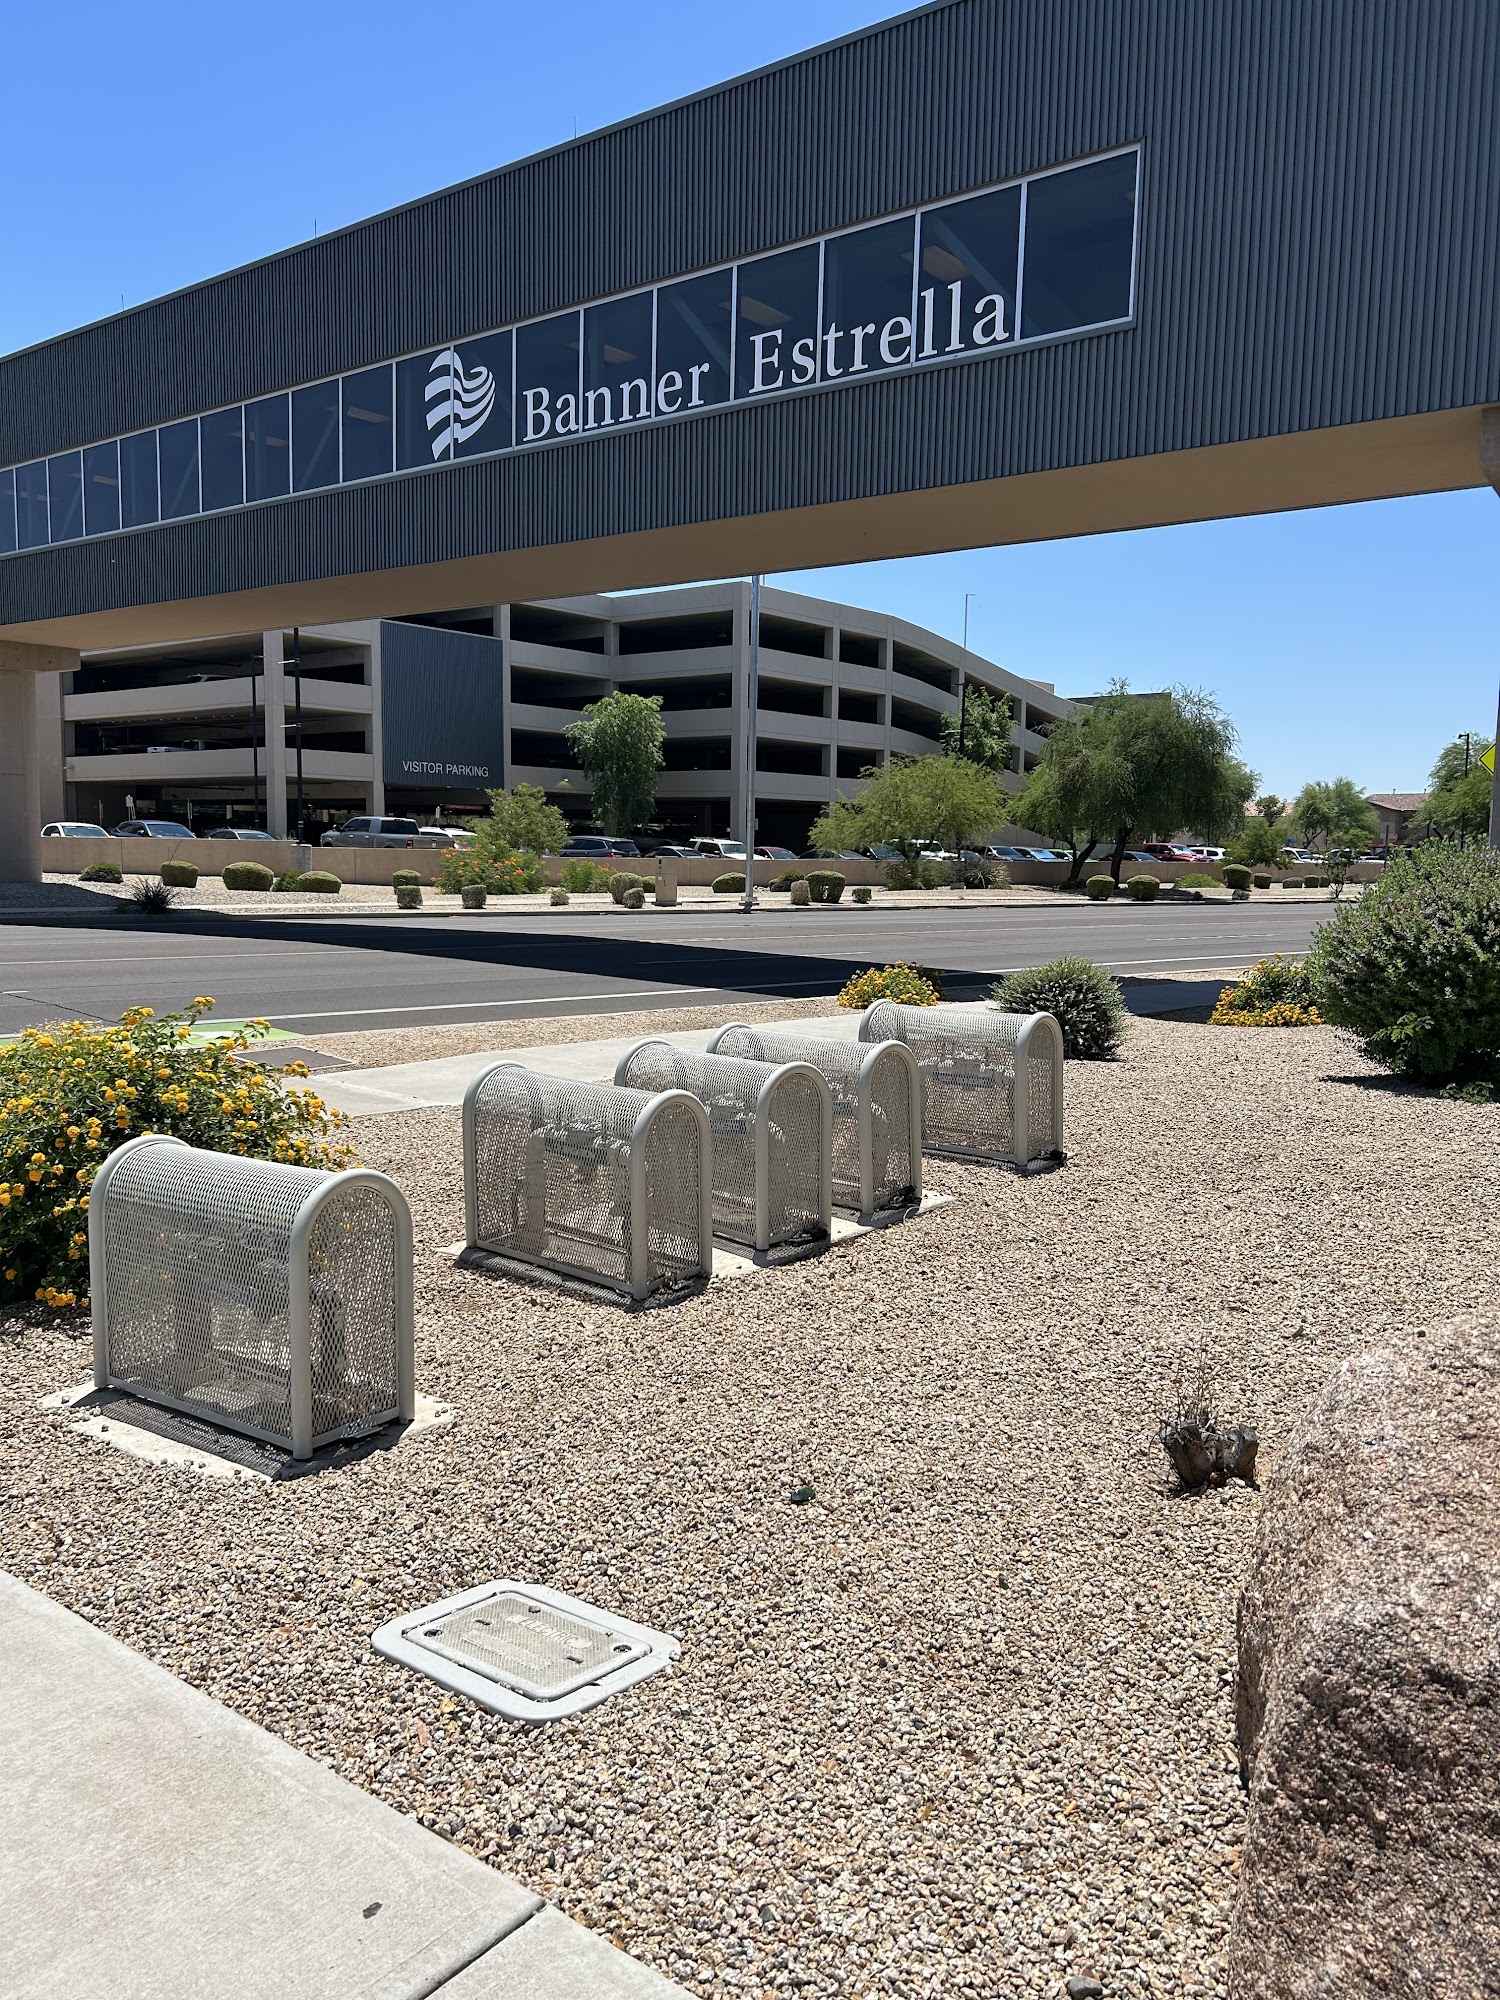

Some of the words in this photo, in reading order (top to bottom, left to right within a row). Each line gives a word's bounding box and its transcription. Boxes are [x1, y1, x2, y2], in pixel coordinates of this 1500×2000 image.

[522, 362, 710, 442] Banner
[748, 280, 1010, 394] Estrella
[402, 761, 443, 774] VISITOR
[446, 764, 489, 777] PARKING
[517, 1618, 579, 1646] ELECTRIC
